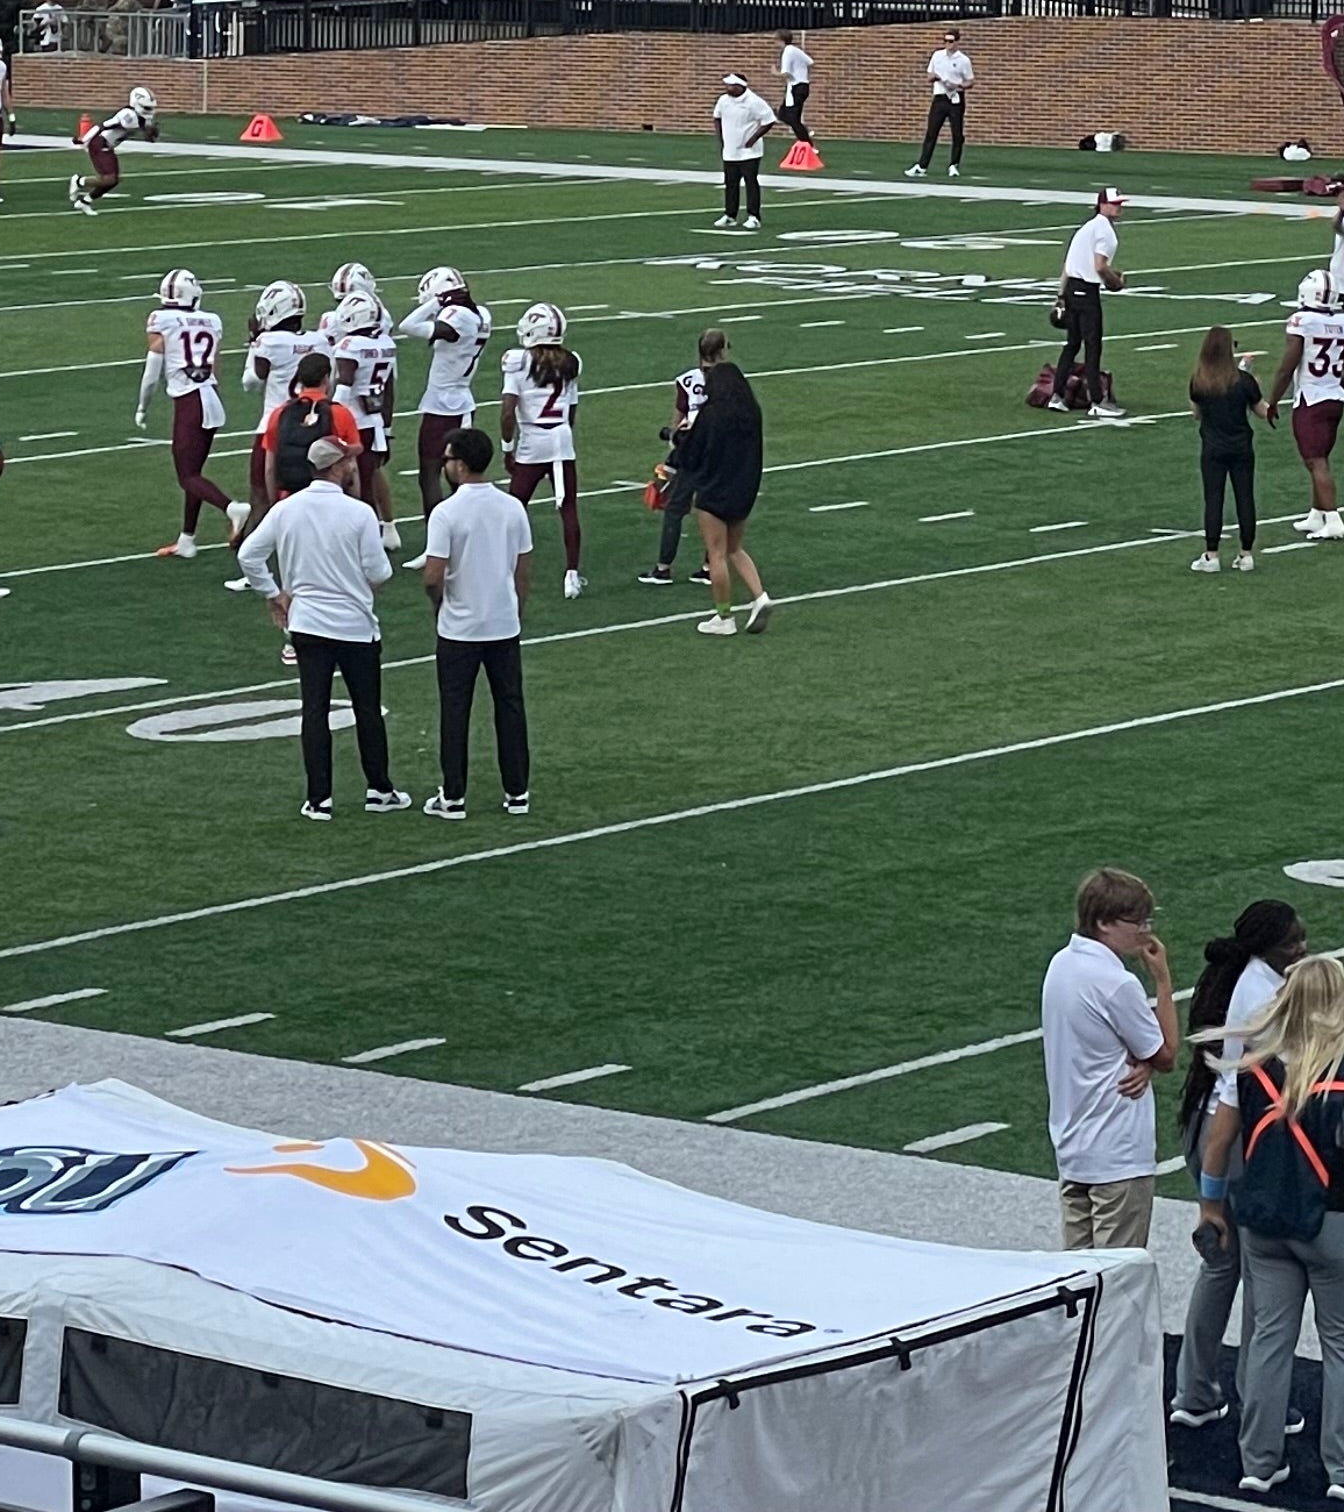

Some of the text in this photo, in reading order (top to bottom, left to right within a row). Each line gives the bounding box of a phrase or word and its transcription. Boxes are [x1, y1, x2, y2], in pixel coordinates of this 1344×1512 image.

[789, 146, 806, 165] 10
[179, 330, 215, 369] 12
[464, 338, 487, 378] 7
[442, 1204, 818, 1339] Sentara
